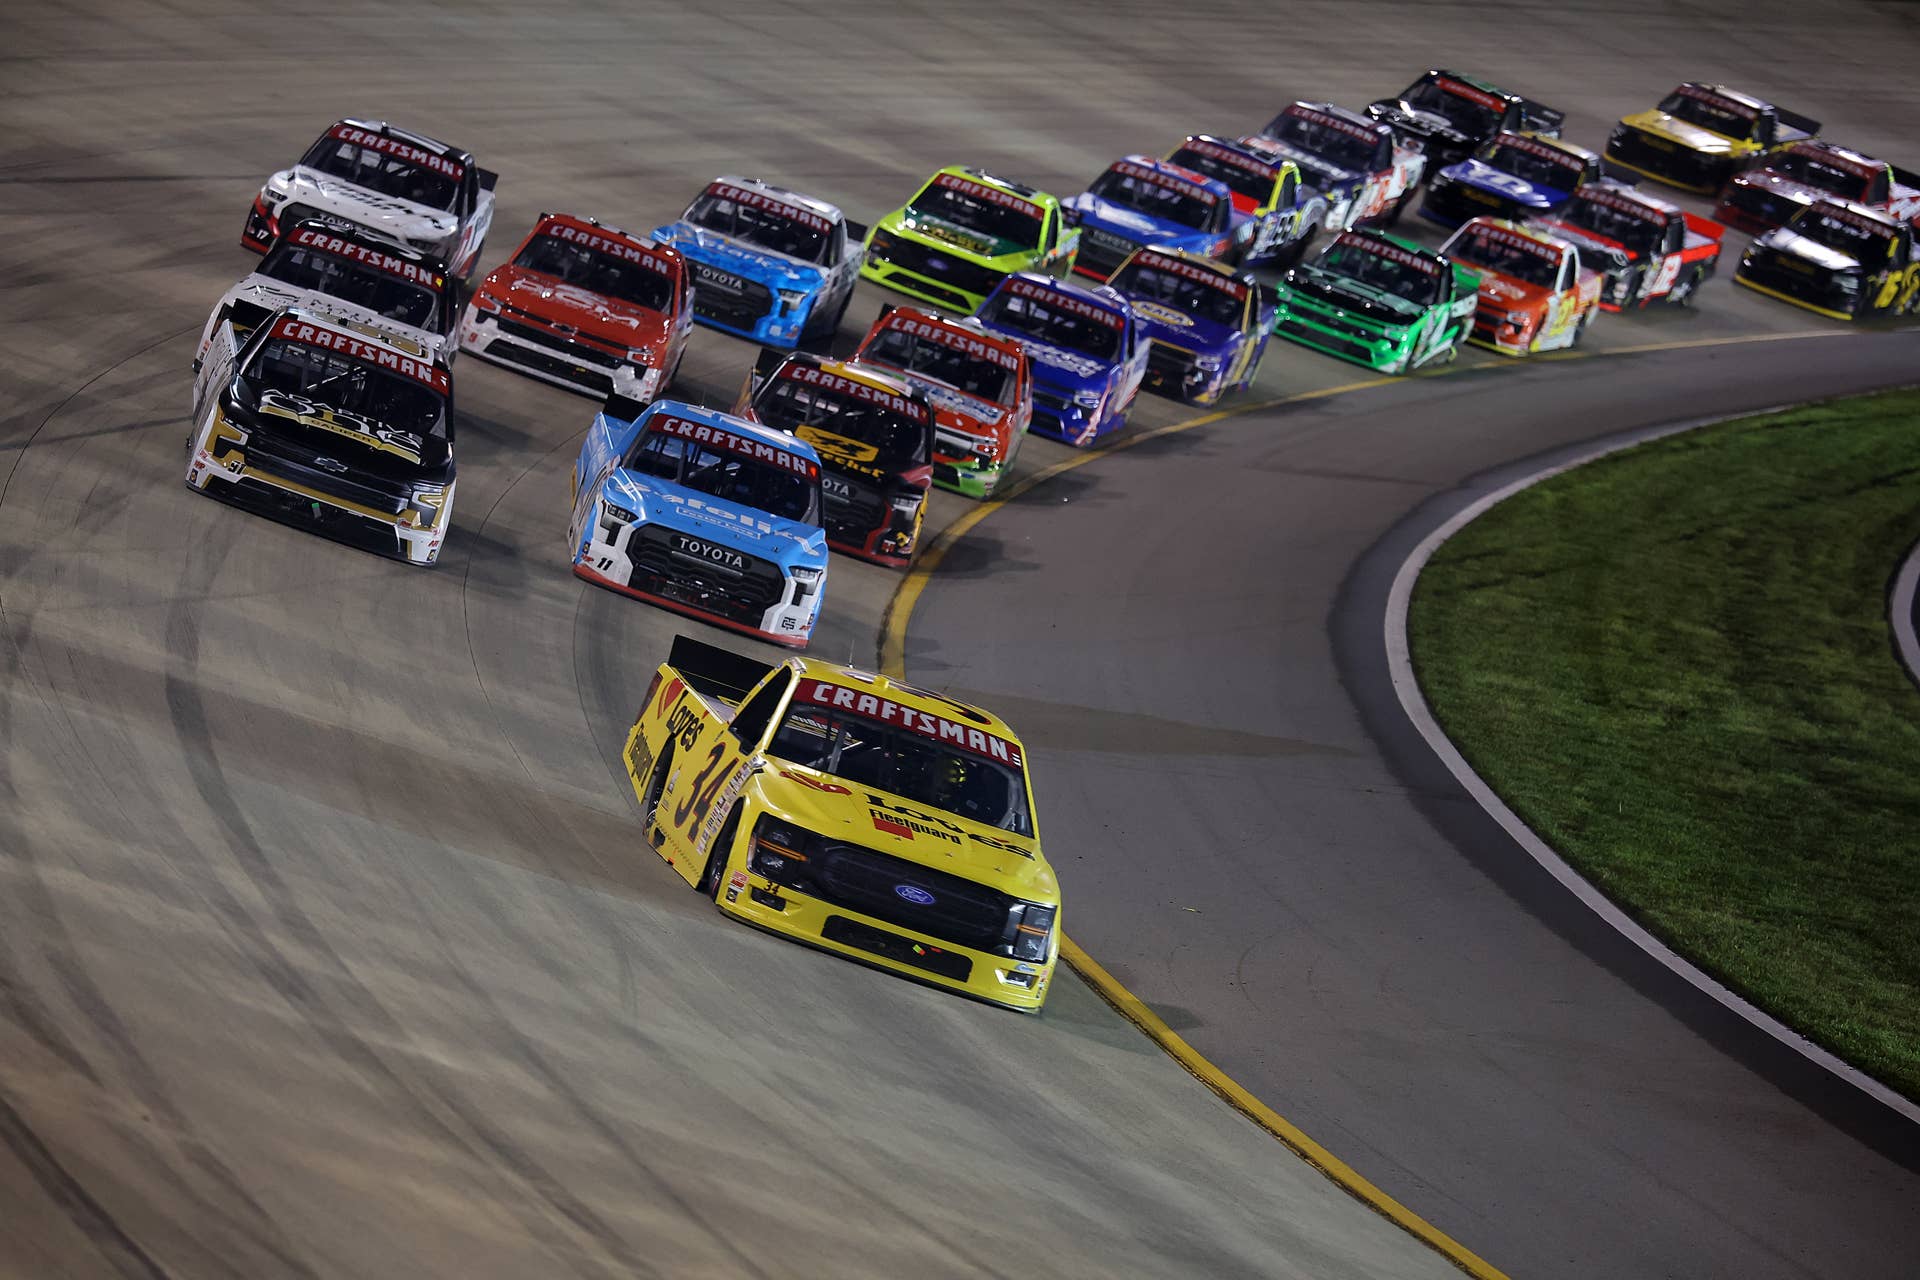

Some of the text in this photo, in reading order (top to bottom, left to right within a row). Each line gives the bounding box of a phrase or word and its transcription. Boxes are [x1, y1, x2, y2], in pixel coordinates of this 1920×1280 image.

[339, 127, 455, 173] CRAFTSMAN
[716, 185, 823, 228] CRAFTSMAN
[940, 175, 1037, 215] CRAFTSMAN
[257, 229, 269, 240] 17
[551, 225, 668, 274] CRAFTSMAN
[299, 231, 433, 286] CRAFTSMAN
[696, 265, 743, 288] TOYOTA
[1139, 252, 1238, 293] CRAFTSMAN
[1011, 281, 1116, 326] CRAFTSMAN
[283, 322, 432, 383] CRAFTSMAN
[890, 318, 1014, 369] CRAFTSMAN
[791, 367, 919, 418] CRAFTSMAN
[663, 418, 807, 475] CRAFTSMAN
[822, 478, 850, 496] OTA
[596, 557, 613, 571] 11
[679, 537, 744, 568] TOYOTA
[813, 684, 1009, 762] CRAFTSMAN
[674, 741, 740, 844] 34
[869, 808, 962, 846] Fleetguard
[763, 880, 780, 896] 34
